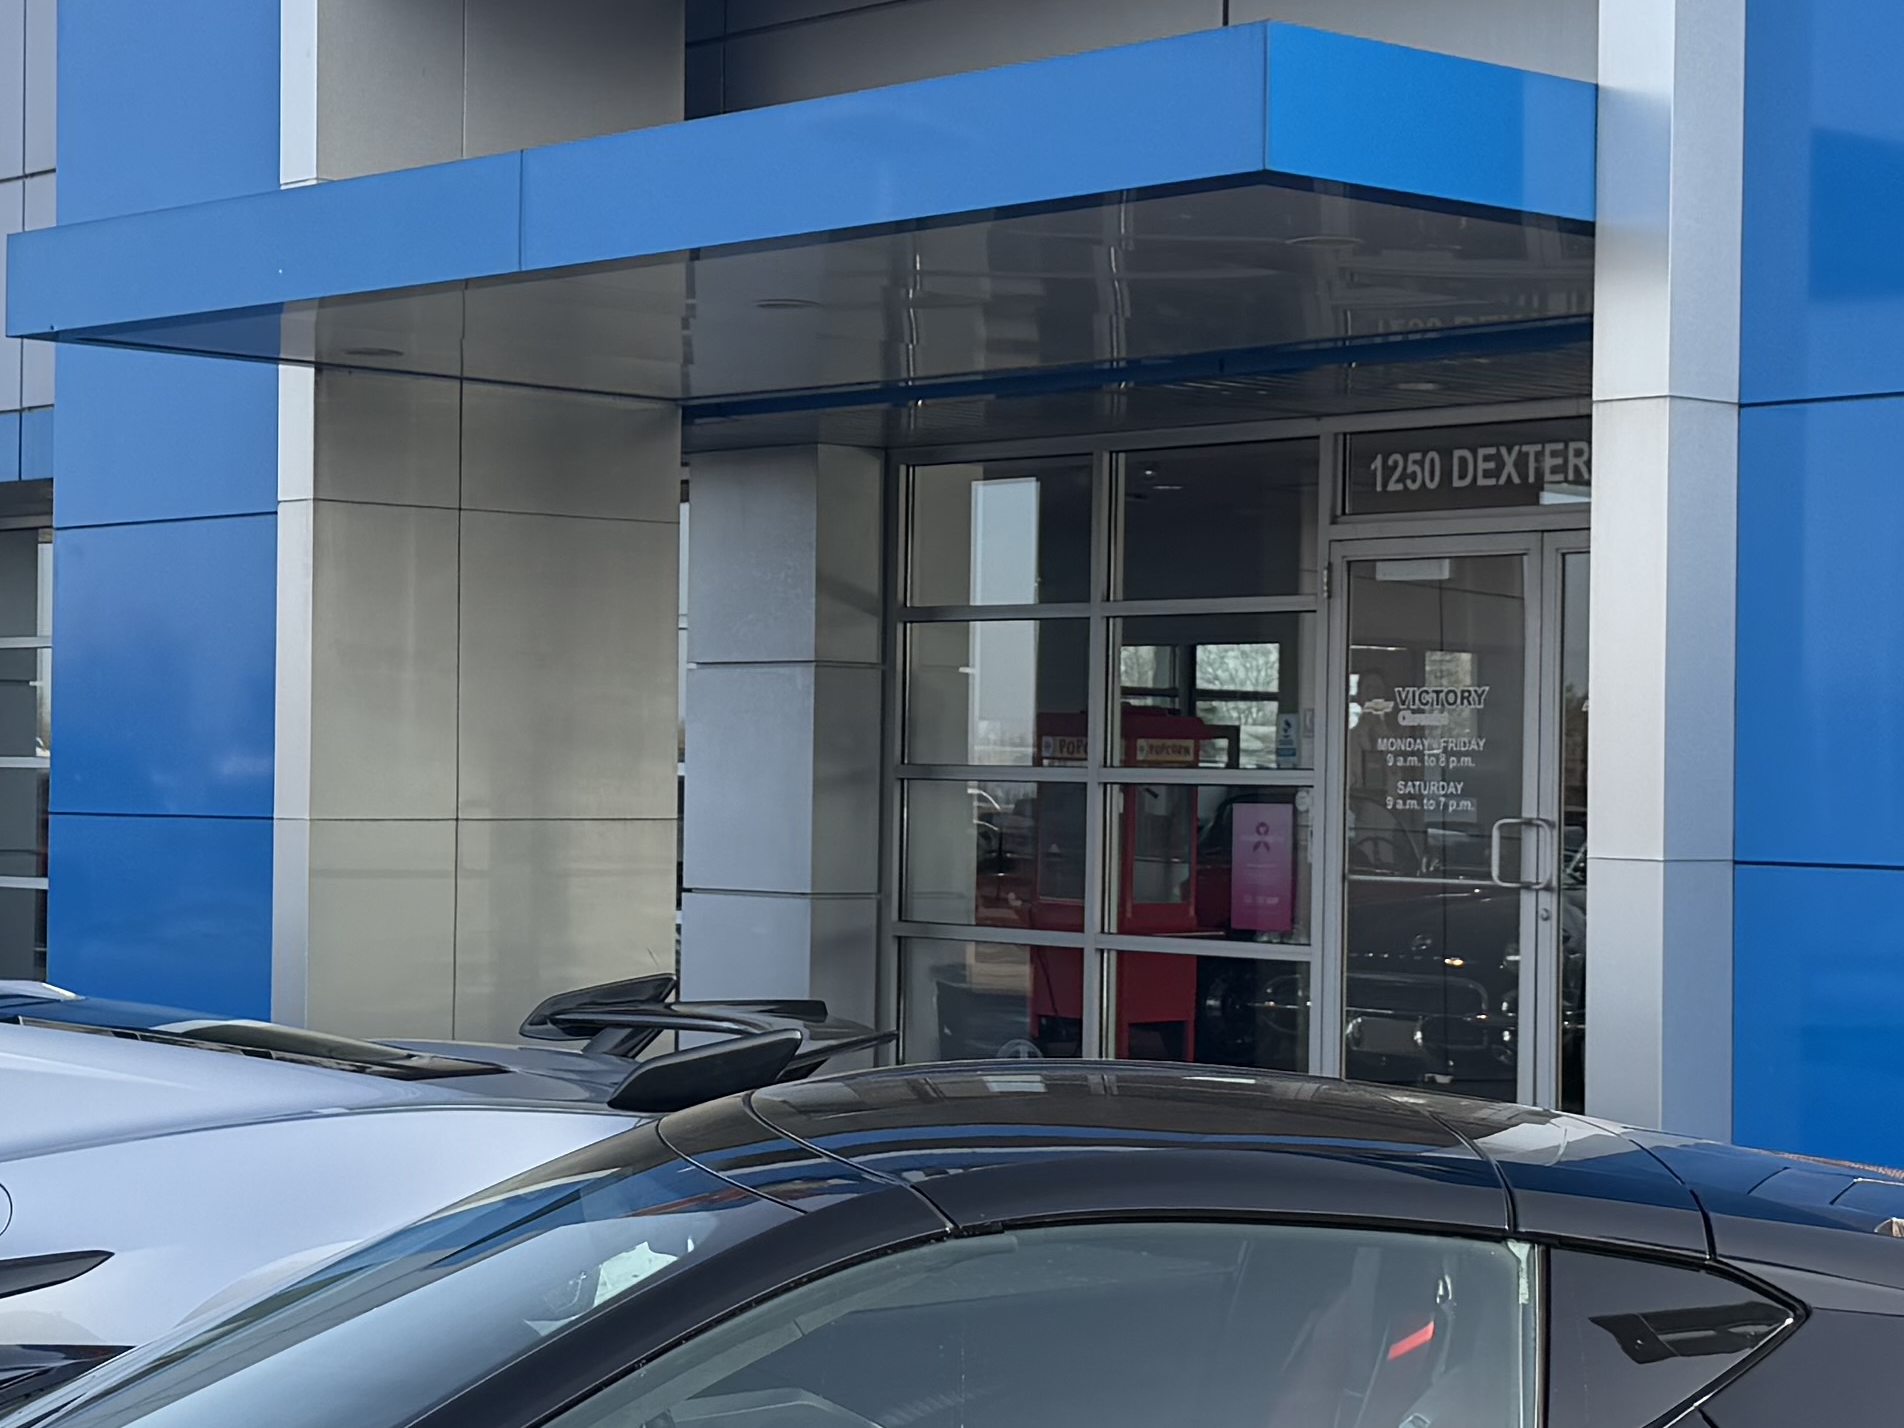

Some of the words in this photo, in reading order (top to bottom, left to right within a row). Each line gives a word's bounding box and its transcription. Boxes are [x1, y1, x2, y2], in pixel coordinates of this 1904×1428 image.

[1370, 450, 1441, 493] 1250
[1452, 440, 1592, 488] DEXTER
[1395, 686, 1489, 709] VICTORY
[1377, 738, 1429, 752] MONDAY
[1440, 738, 1486, 751] FRIDAY
[1386, 754, 1393, 766] 9
[1396, 756, 1422, 766] a.m.
[1424, 754, 1436, 766] to
[1439, 754, 1446, 766] 8
[1449, 756, 1476, 769] p.m.
[1396, 781, 1464, 795] SATURDAY
[1386, 797, 1393, 809] 9
[1423, 797, 1436, 809] to
[1438, 797, 1445, 809] 7
